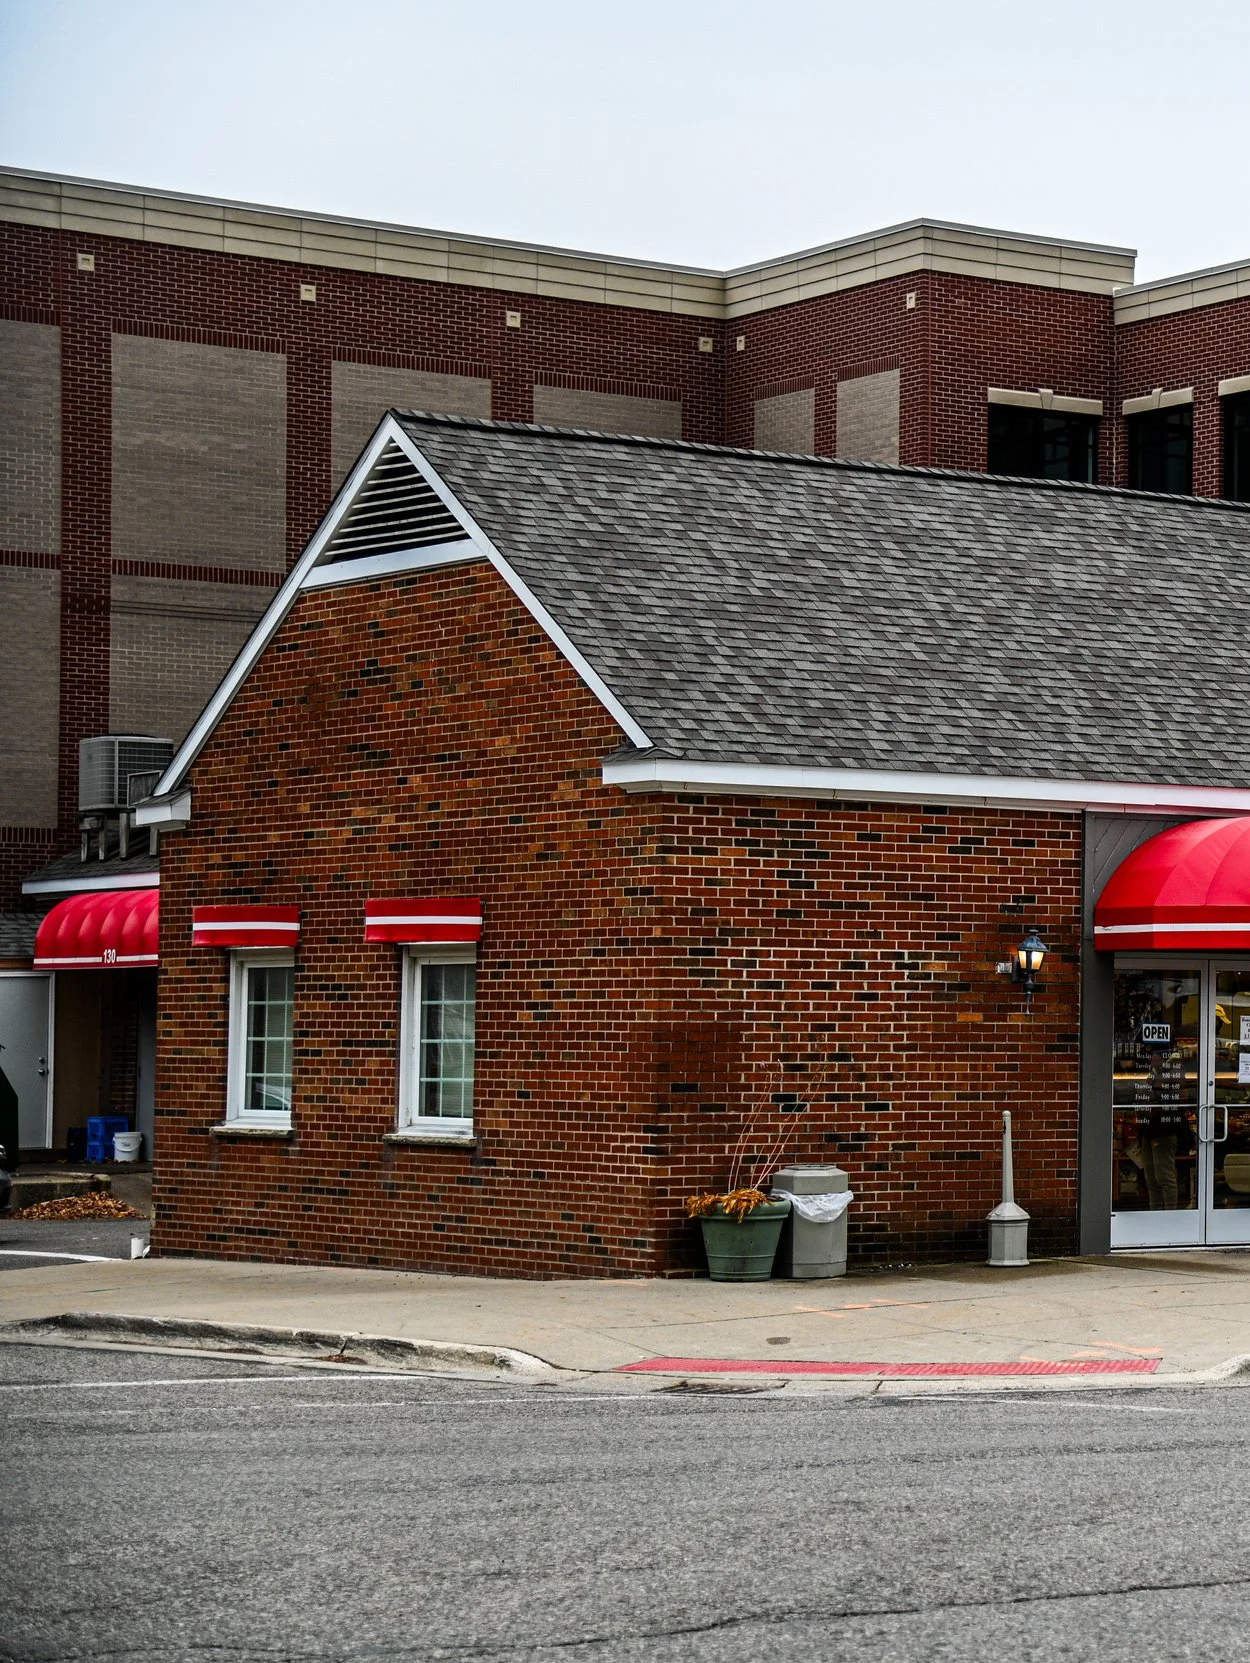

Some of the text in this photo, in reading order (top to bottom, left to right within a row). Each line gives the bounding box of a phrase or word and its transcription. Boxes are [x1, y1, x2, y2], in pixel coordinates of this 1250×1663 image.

[103, 949, 116, 963] 130
[1143, 1025, 1169, 1040] OPEN
[1135, 1093, 1150, 1101] Friday
